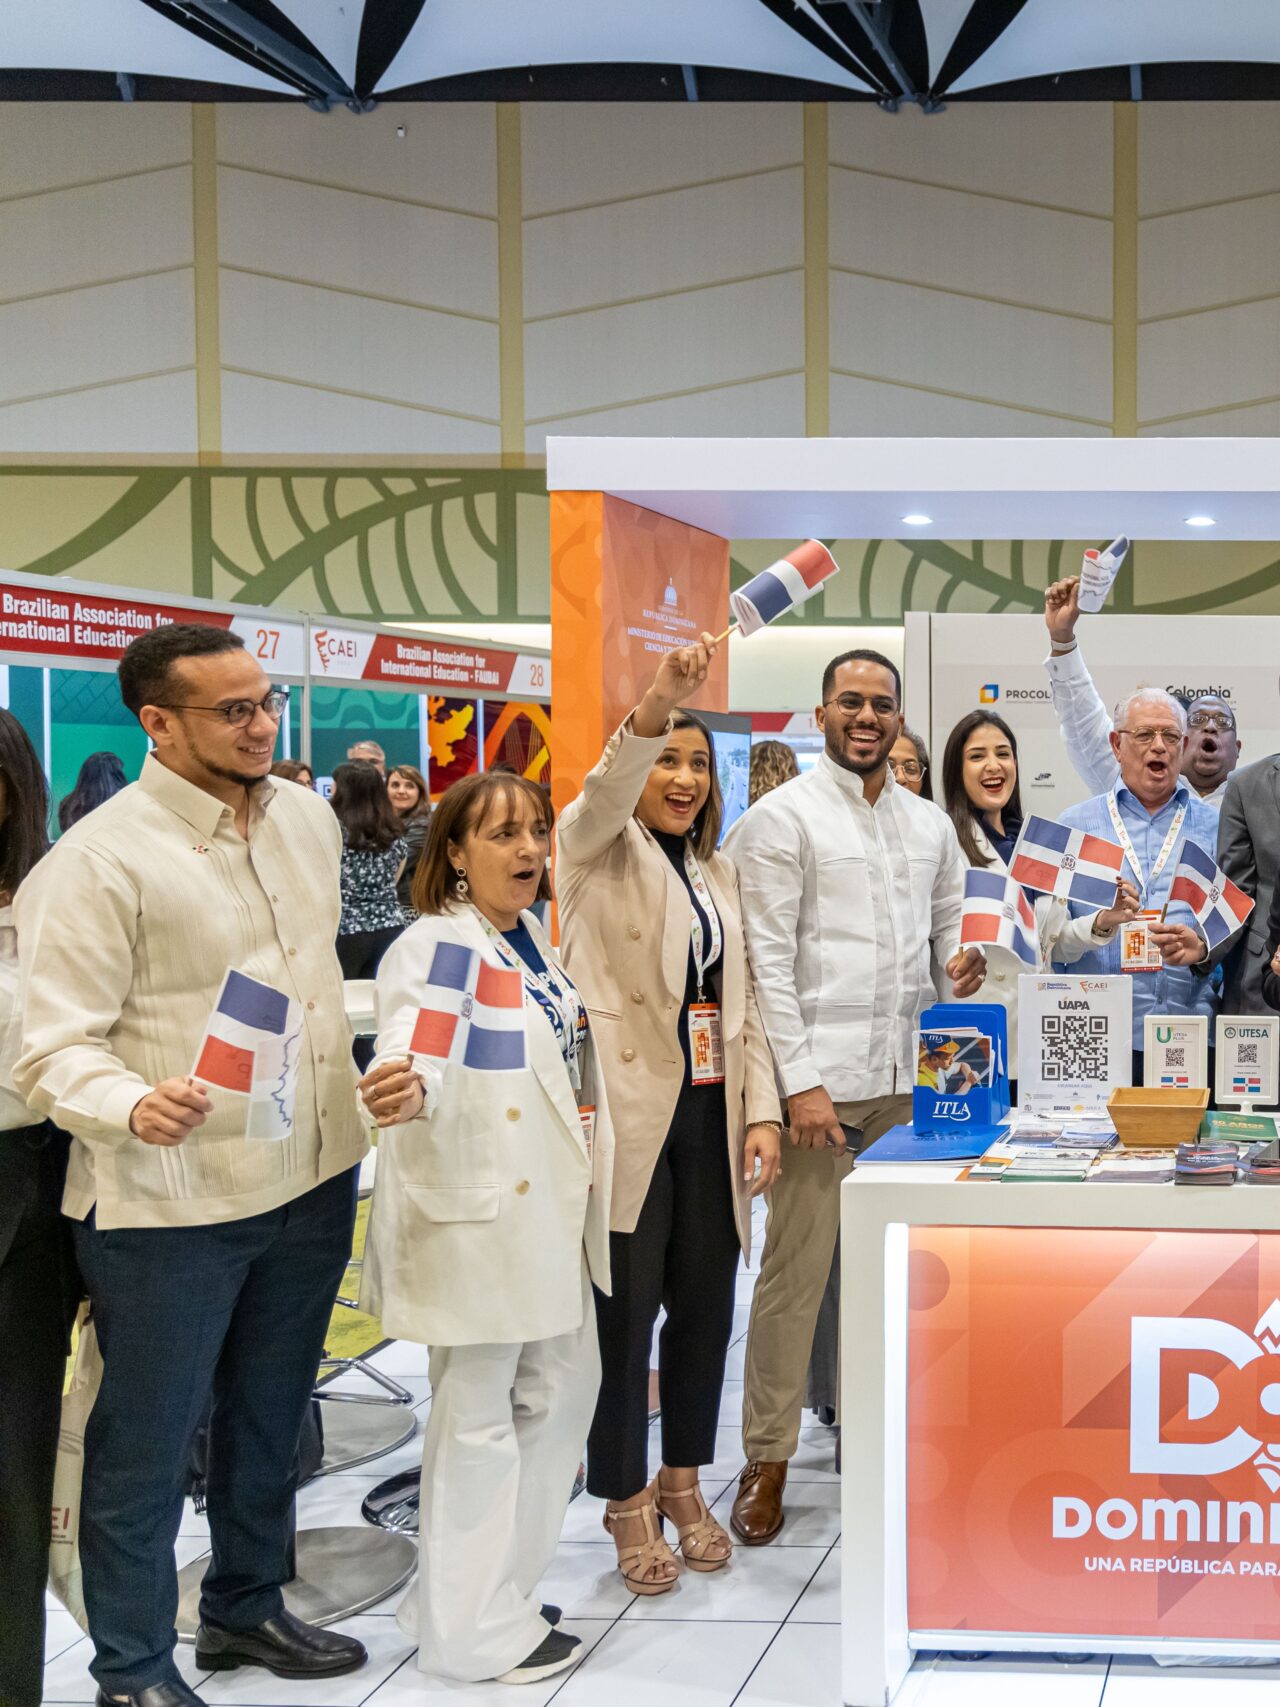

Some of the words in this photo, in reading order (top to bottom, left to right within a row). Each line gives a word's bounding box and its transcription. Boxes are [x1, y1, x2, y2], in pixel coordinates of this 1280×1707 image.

[3, 593, 69, 620] Brazilian
[74, 603, 152, 630] Association
[156, 613, 174, 627] for
[0, 619, 70, 643] rnational
[256, 629, 281, 660] 27
[327, 638, 358, 658] CAEI
[397, 644, 431, 662] Brazilian
[433, 649, 474, 668] Association
[475, 654, 486, 669] for
[381, 659, 431, 679] International
[433, 664, 469, 682] Education
[475, 669, 499, 685] FAUBAI
[530, 664, 544, 687] 28
[1006, 690, 1050, 699] PROCOL
[1058, 1000, 1090, 1010] UAPA
[1239, 1029, 1269, 1038] UTESA
[932, 1101, 971, 1119] ITLA
[1084, 1557, 1126, 1573] UNA
[1131, 1555, 1235, 1577] REPÚBLICA
